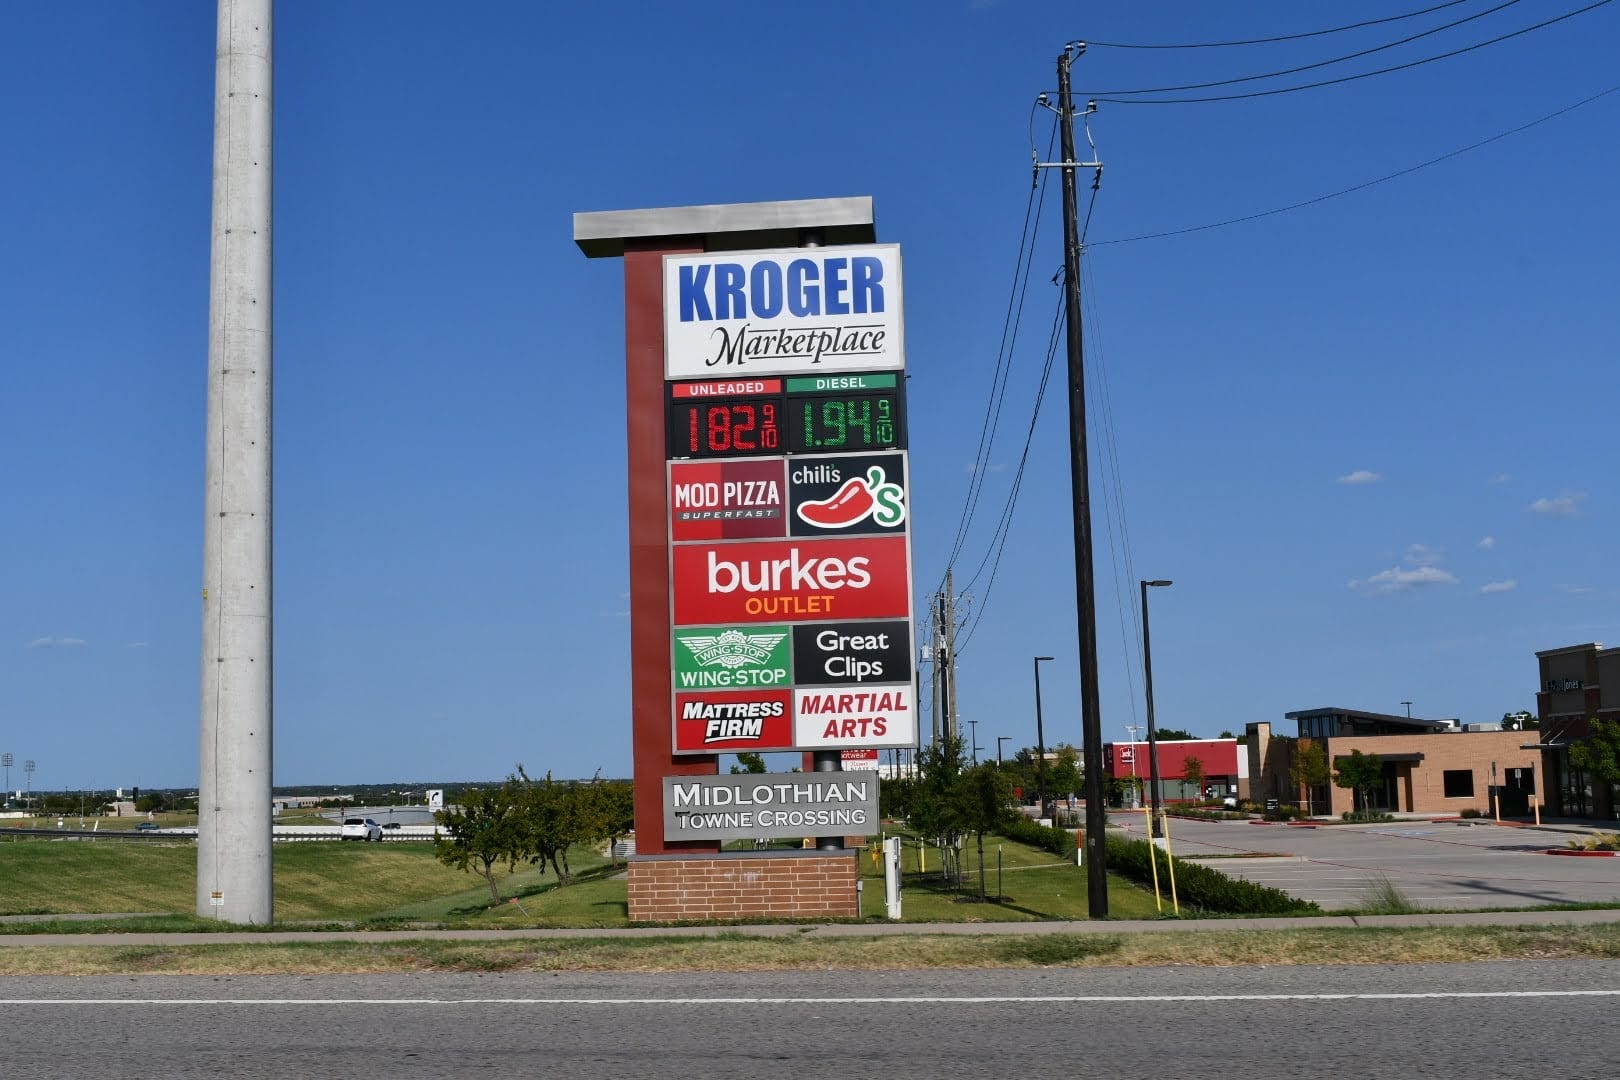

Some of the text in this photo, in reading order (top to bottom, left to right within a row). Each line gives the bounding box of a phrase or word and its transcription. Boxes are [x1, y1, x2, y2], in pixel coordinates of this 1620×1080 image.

[679, 256, 885, 322] KROGER
[705, 323, 886, 367] Marketplace
[689, 382, 765, 396] UNLEADED
[816, 378, 867, 390] DIESEL
[792, 463, 841, 485] chili's
[675, 480, 780, 508] MOD PIZZA
[682, 509, 775, 520] SUPERFAST
[707, 548, 872, 594] burkes
[745, 595, 835, 615] OUTLET
[816, 630, 890, 651] Great
[824, 656, 884, 682] Clips
[682, 701, 784, 720] MATTRESS
[800, 691, 908, 715] MARTIAL
[705, 718, 763, 738] FIRM
[822, 716, 888, 739] ARTS
[673, 782, 867, 808] MIDLOTHIAN
[675, 808, 866, 830] TOWNE CROSSING
